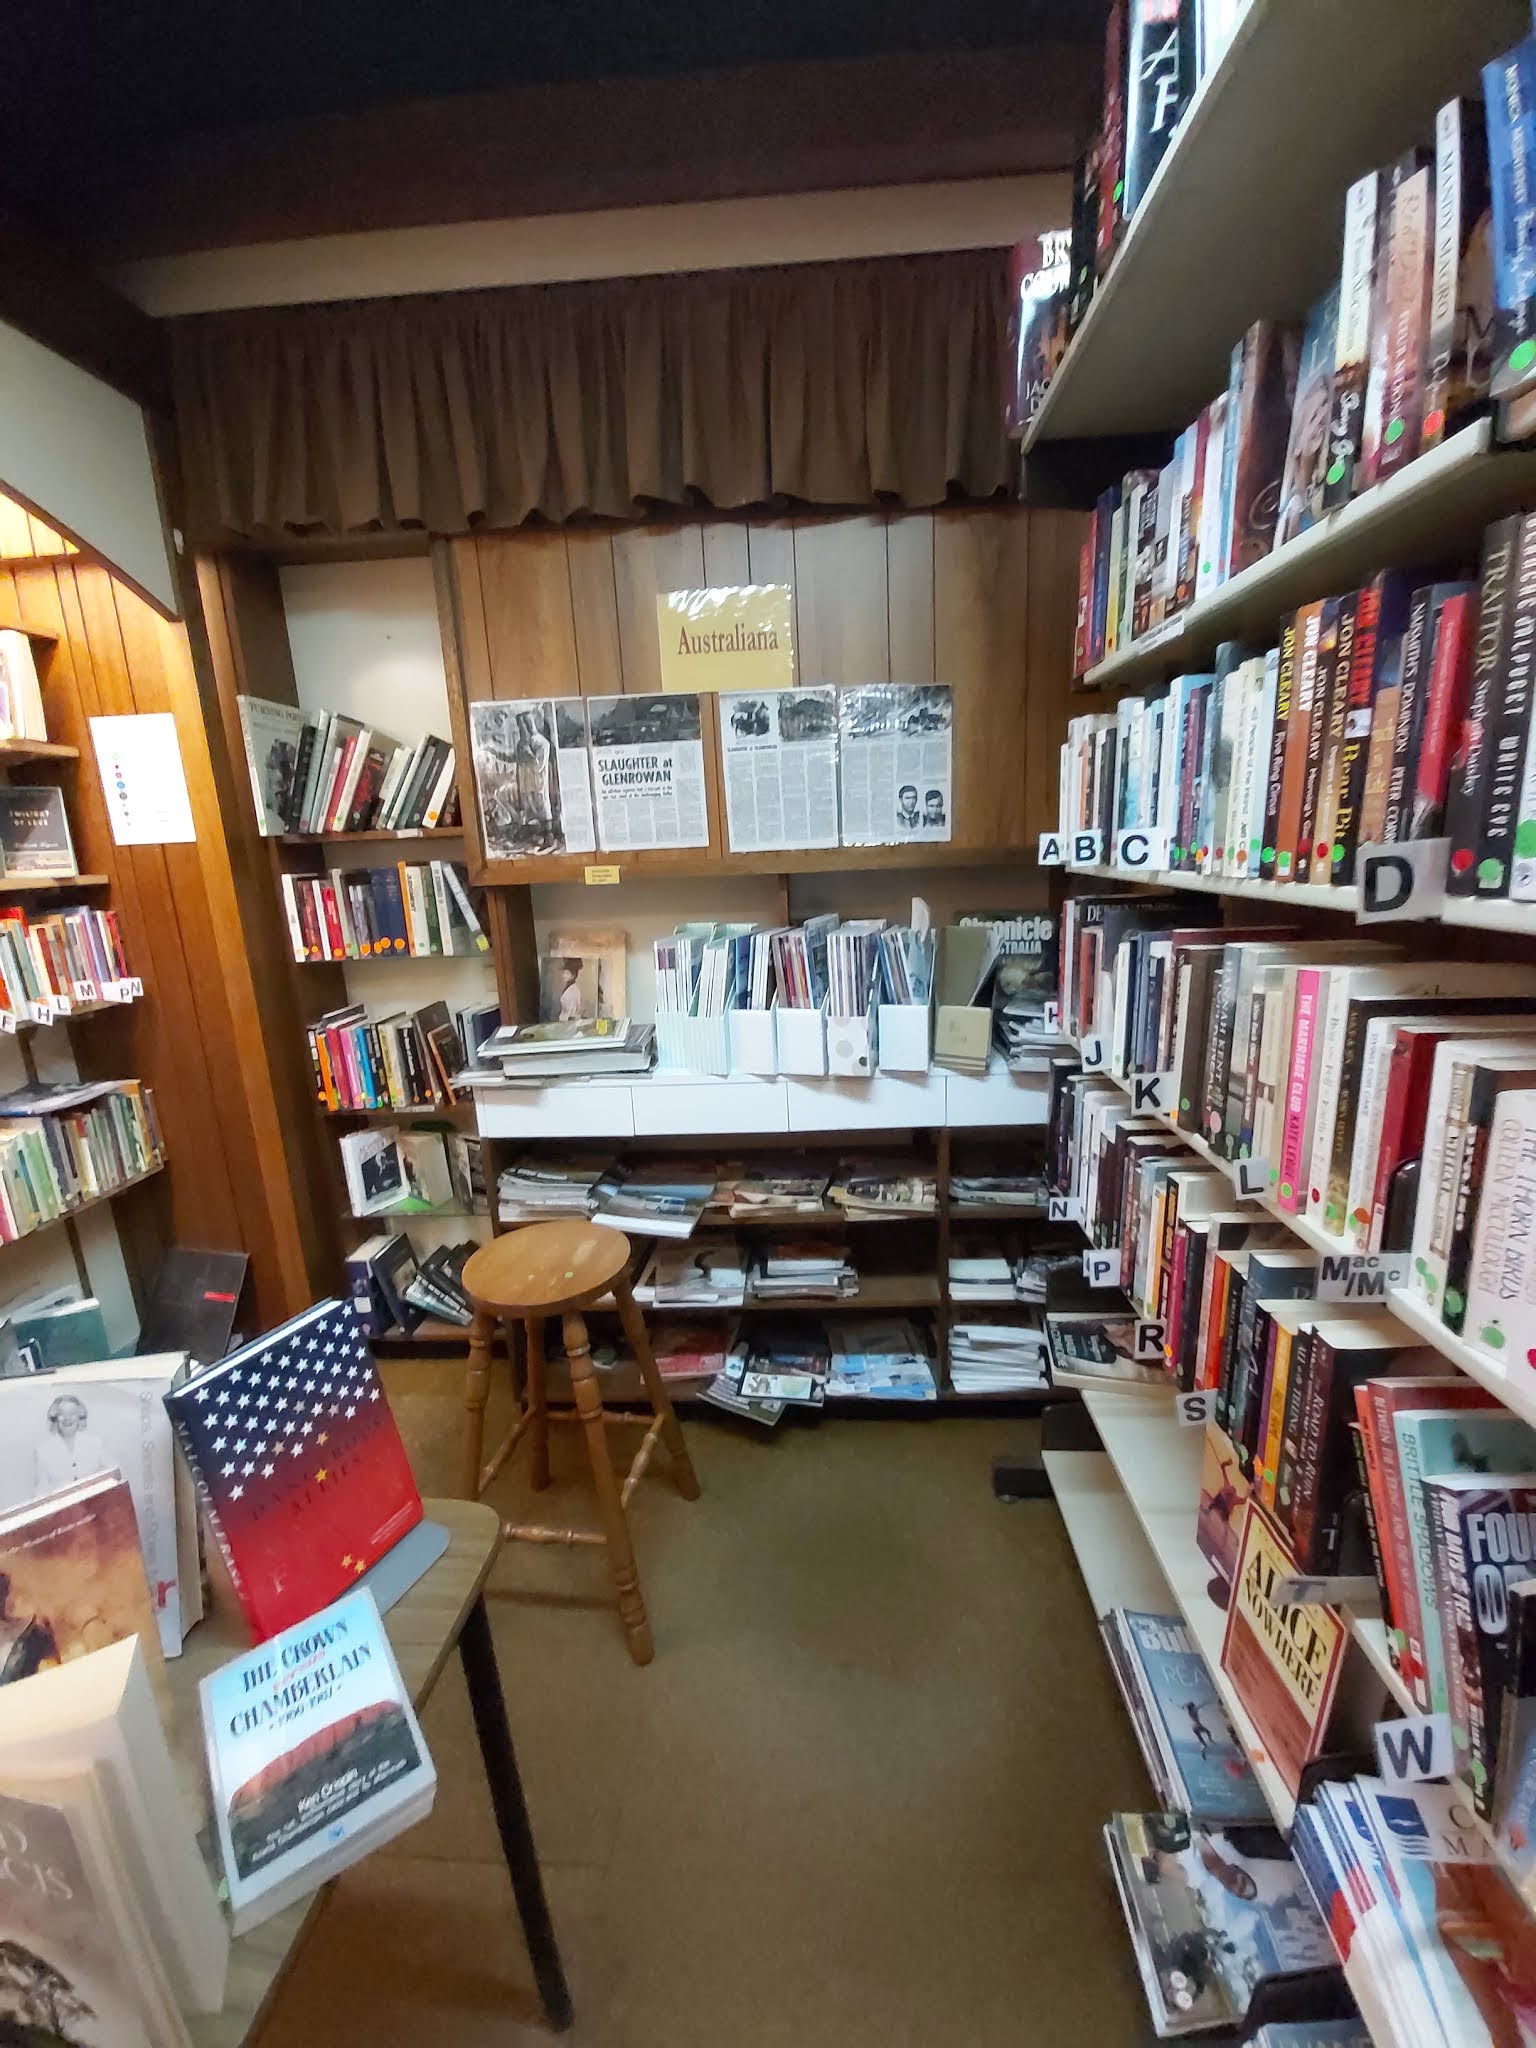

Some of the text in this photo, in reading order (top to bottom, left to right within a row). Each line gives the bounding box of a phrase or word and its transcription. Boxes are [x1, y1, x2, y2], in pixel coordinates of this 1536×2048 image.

[1437, 150, 1455, 320] MANDY MAGRO
[1474, 540, 1512, 677] TRAITOR
[677, 622, 780, 656] Australiana
[1276, 625, 1296, 721] JON CLEARY
[1298, 615, 1321, 712] JON CLEARY
[1329, 613, 1355, 739] JON CLEARY
[1308, 665, 1328, 761] JON CLEARY
[1396, 682, 1417, 754] DOMINION
[597, 756, 673, 773] SLAUGHTER at
[601, 770, 672, 786] GLENROWAN
[1491, 735, 1521, 797] WHITE
[1042, 838, 1060, 861] A
[1075, 836, 1097, 862] B
[1121, 834, 1149, 866] C
[1365, 855, 1414, 914] D
[80, 983, 95, 998] M
[131, 981, 142, 995] N
[1300, 993, 1313, 1016] THE
[37, 1007, 50, 1022] H
[1084, 1040, 1102, 1066] J
[1214, 1038, 1227, 1084] KENT
[1293, 1019, 1310, 1080] MARRIAGE
[1135, 1077, 1161, 1110] K
[1289, 1080, 1304, 1114] CLUB
[1287, 1114, 1299, 1142] KATE
[1495, 1118, 1522, 1186] COLLEEN
[1240, 1164, 1265, 1195] L
[1051, 1200, 1069, 1219] N
[1509, 1174, 1536, 1246] THORN
[1093, 1260, 1111, 1281] P
[1500, 1246, 1529, 1301] BIRDS
[1138, 1323, 1165, 1352] R
[1183, 1397, 1207, 1421] S
[1312, 1397, 1325, 1442] ROAD
[1309, 1442, 1319, 1460] TO
[176, 1420, 222, 1526] MALCOLM
[1302, 1461, 1317, 1501] RUIN
[1401, 1431, 1438, 1611] BRITTLE SHADOWS
[1467, 1511, 1536, 1564] FOU
[242, 1616, 349, 1693] THE CROWN
[229, 1641, 373, 1738] CHAMBERLAIN
[1382, 1724, 1434, 1780] W
